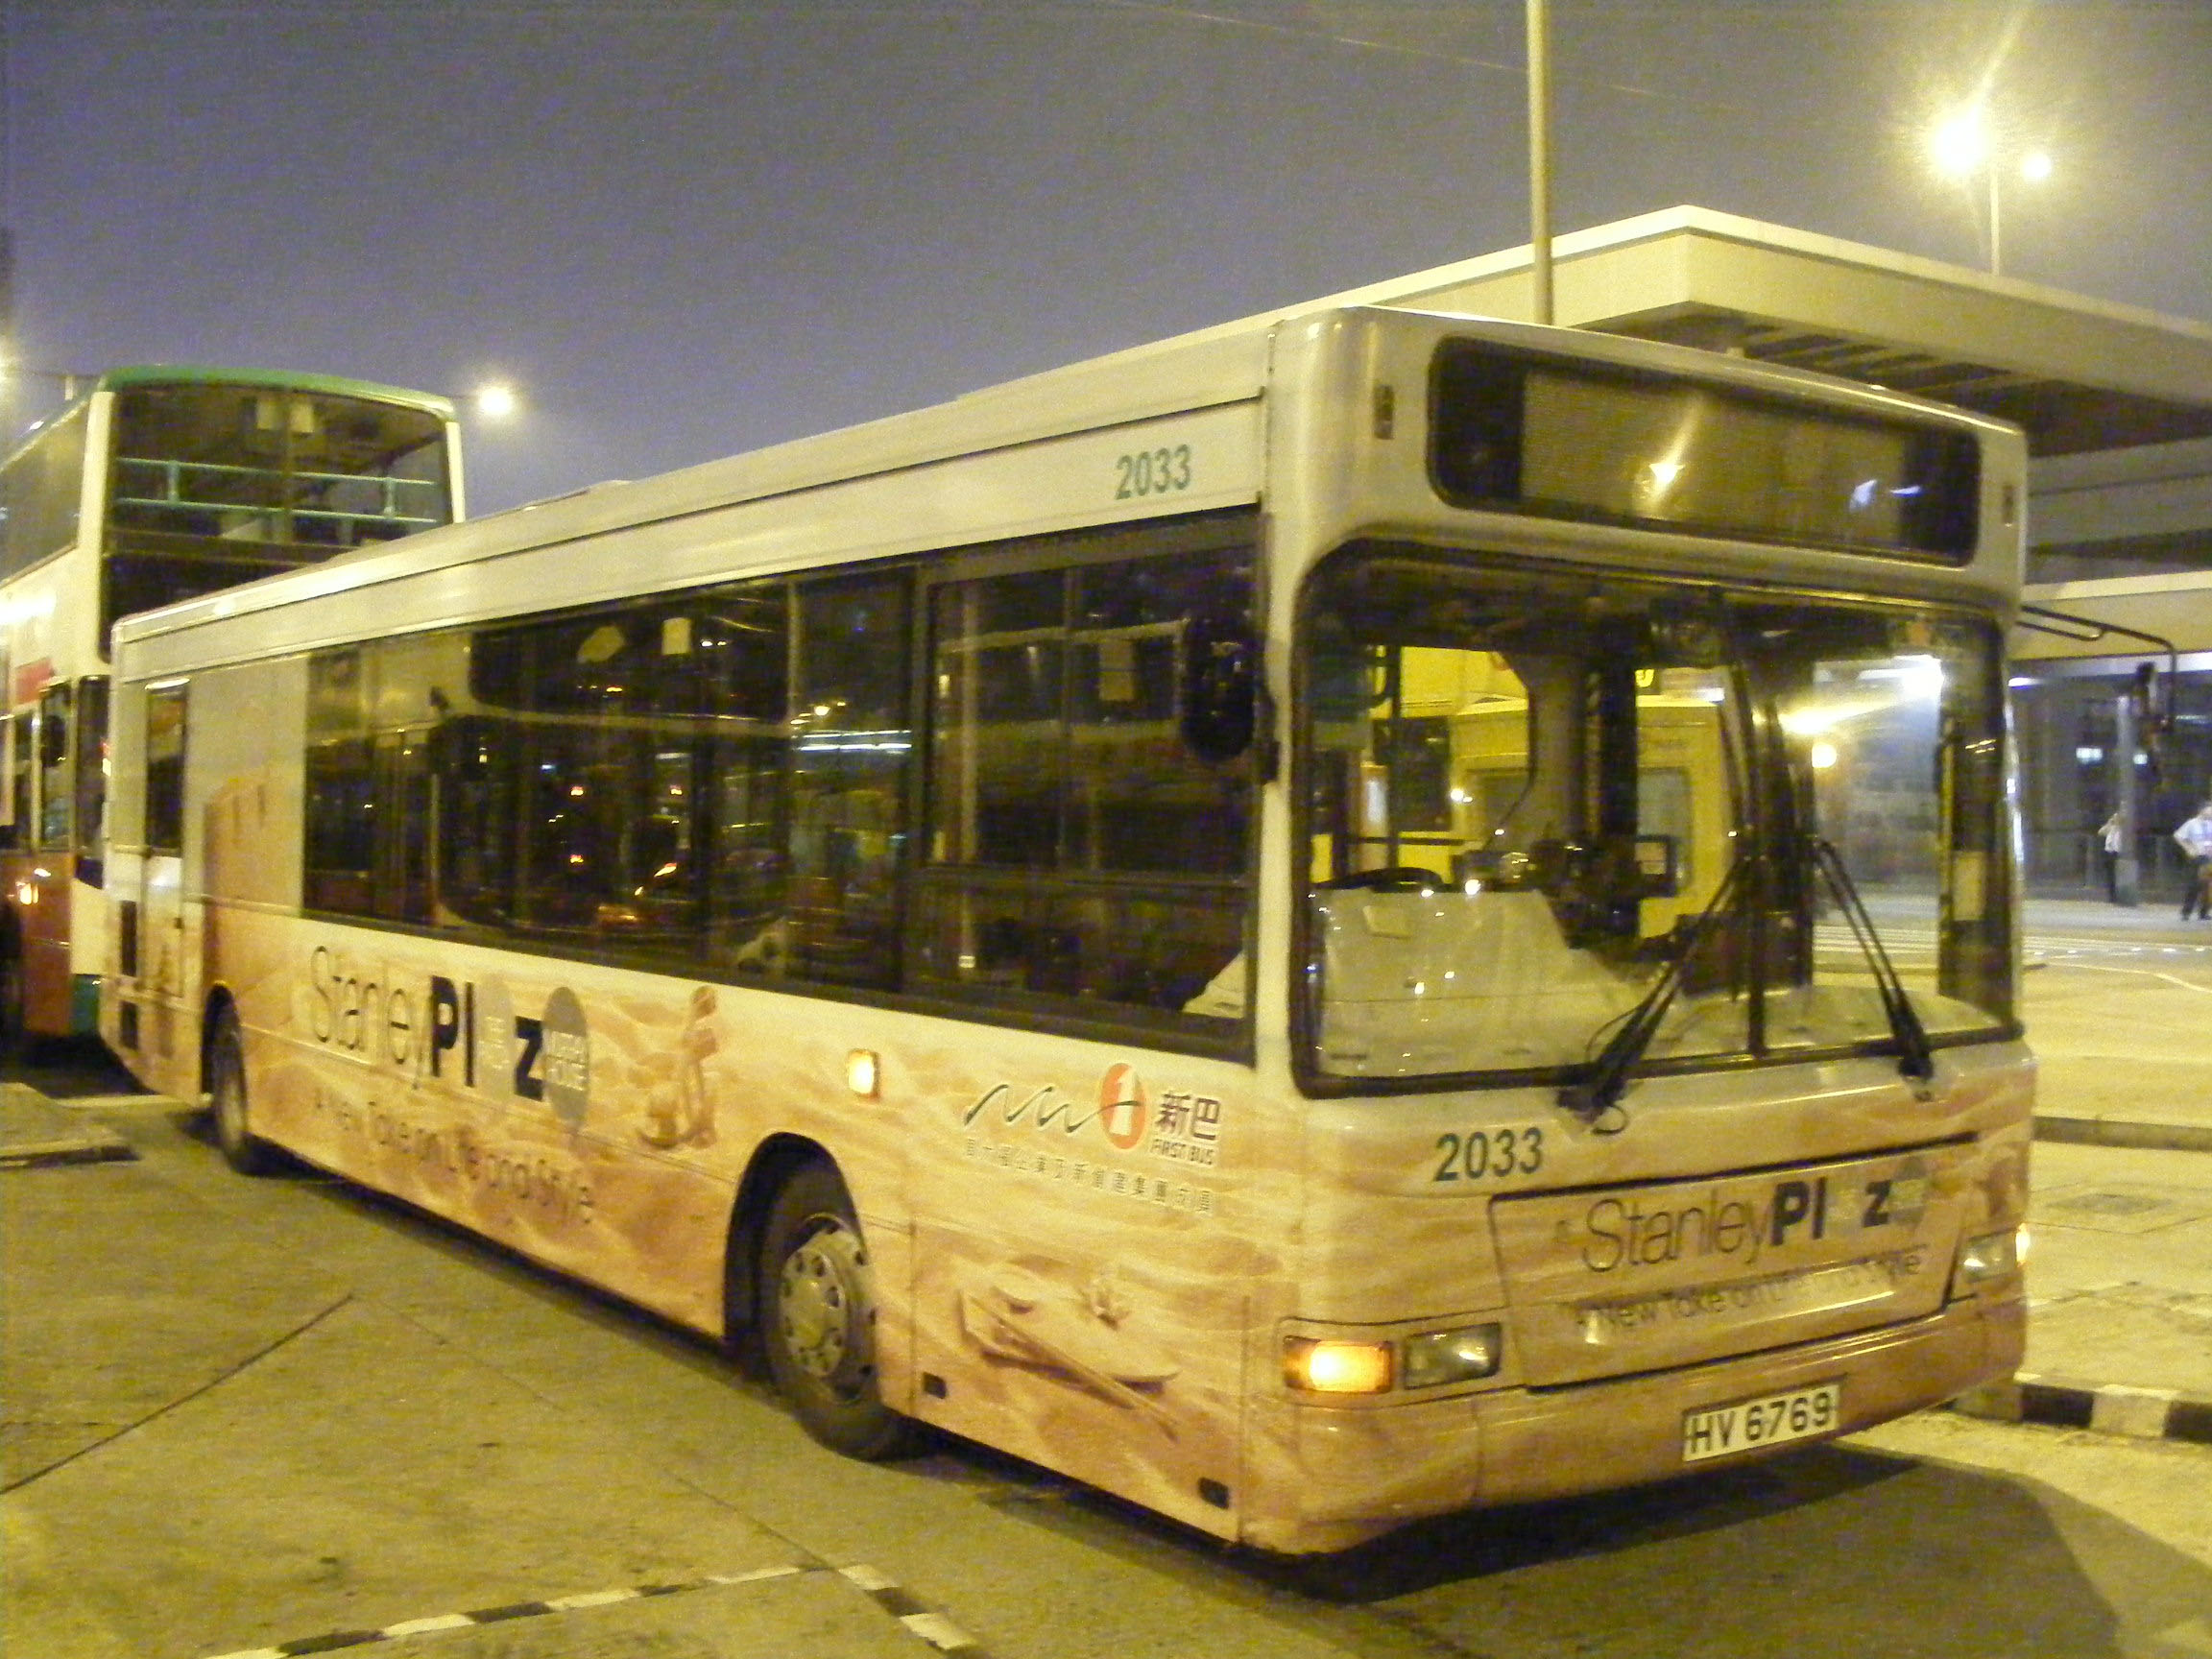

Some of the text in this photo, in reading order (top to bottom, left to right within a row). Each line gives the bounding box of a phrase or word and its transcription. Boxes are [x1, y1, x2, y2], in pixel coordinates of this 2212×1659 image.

[1116, 444, 1190, 499] 2033
[1156, 1091, 1220, 1141] 新巴
[1153, 1139, 1214, 1165] FIRST BUS
[1433, 1126, 1542, 1182] 2033
[1690, 1392, 1830, 1454] HV 6769
